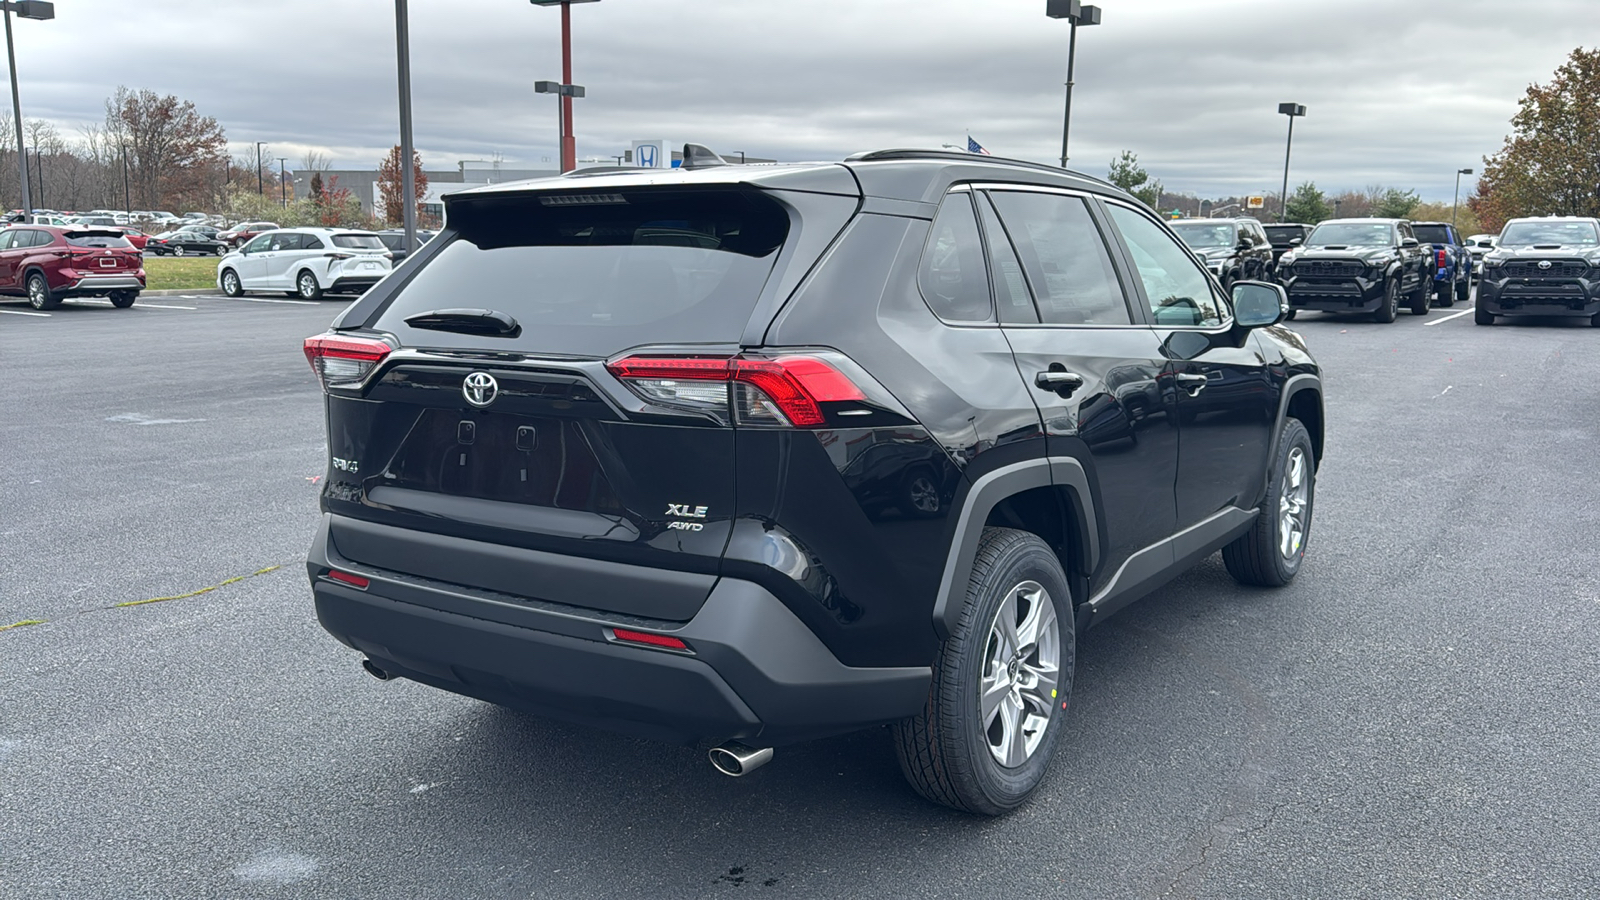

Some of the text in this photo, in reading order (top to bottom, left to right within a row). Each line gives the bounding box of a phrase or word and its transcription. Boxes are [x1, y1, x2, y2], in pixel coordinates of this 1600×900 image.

[332, 456, 359, 474] RAV4
[664, 503, 709, 518] XLE
[667, 521, 704, 532] AWD
